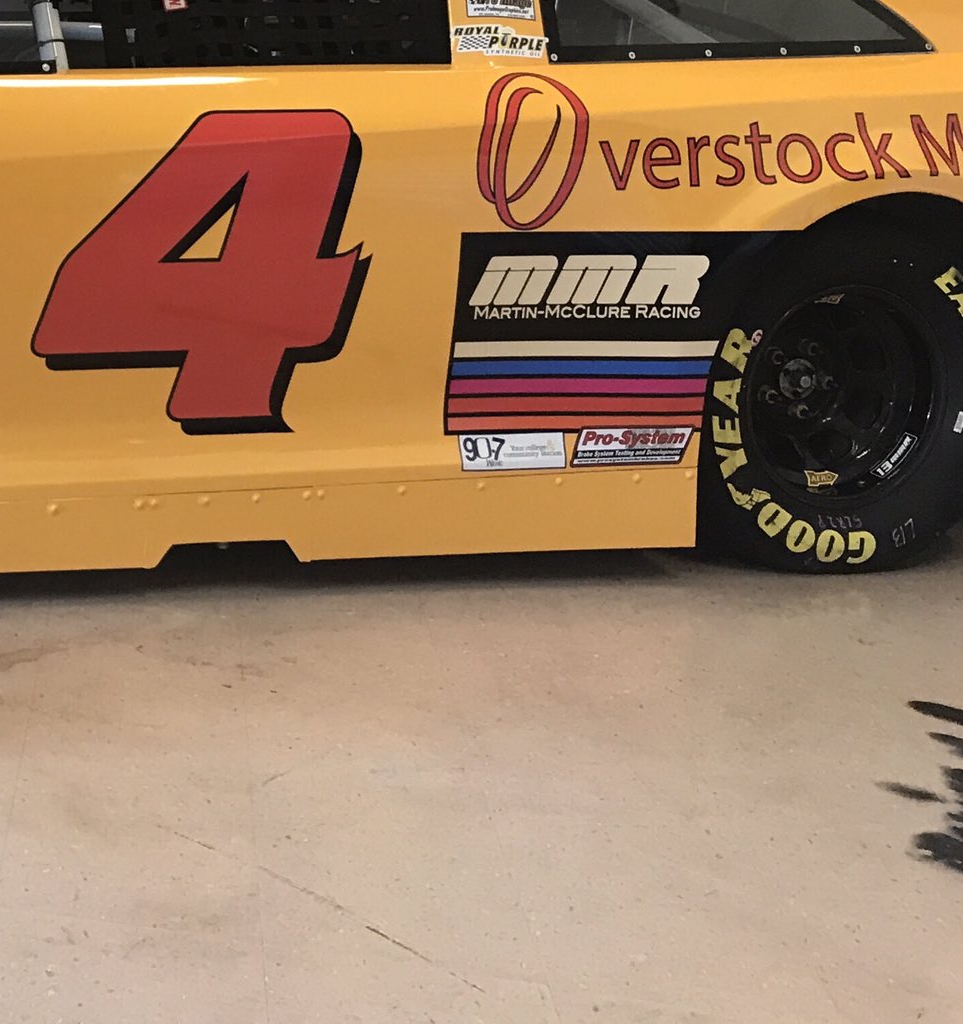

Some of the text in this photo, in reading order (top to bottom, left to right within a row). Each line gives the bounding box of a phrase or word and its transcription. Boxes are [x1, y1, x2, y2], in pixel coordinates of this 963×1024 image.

[454, 26, 499, 36] ROYAL
[488, 33, 544, 51] PURPLE
[31, 109, 373, 435] 4
[635, 304, 701, 320] RACING
[582, 430, 686, 448] Pro-System
[711, 327, 877, 565] GOODYEAR
